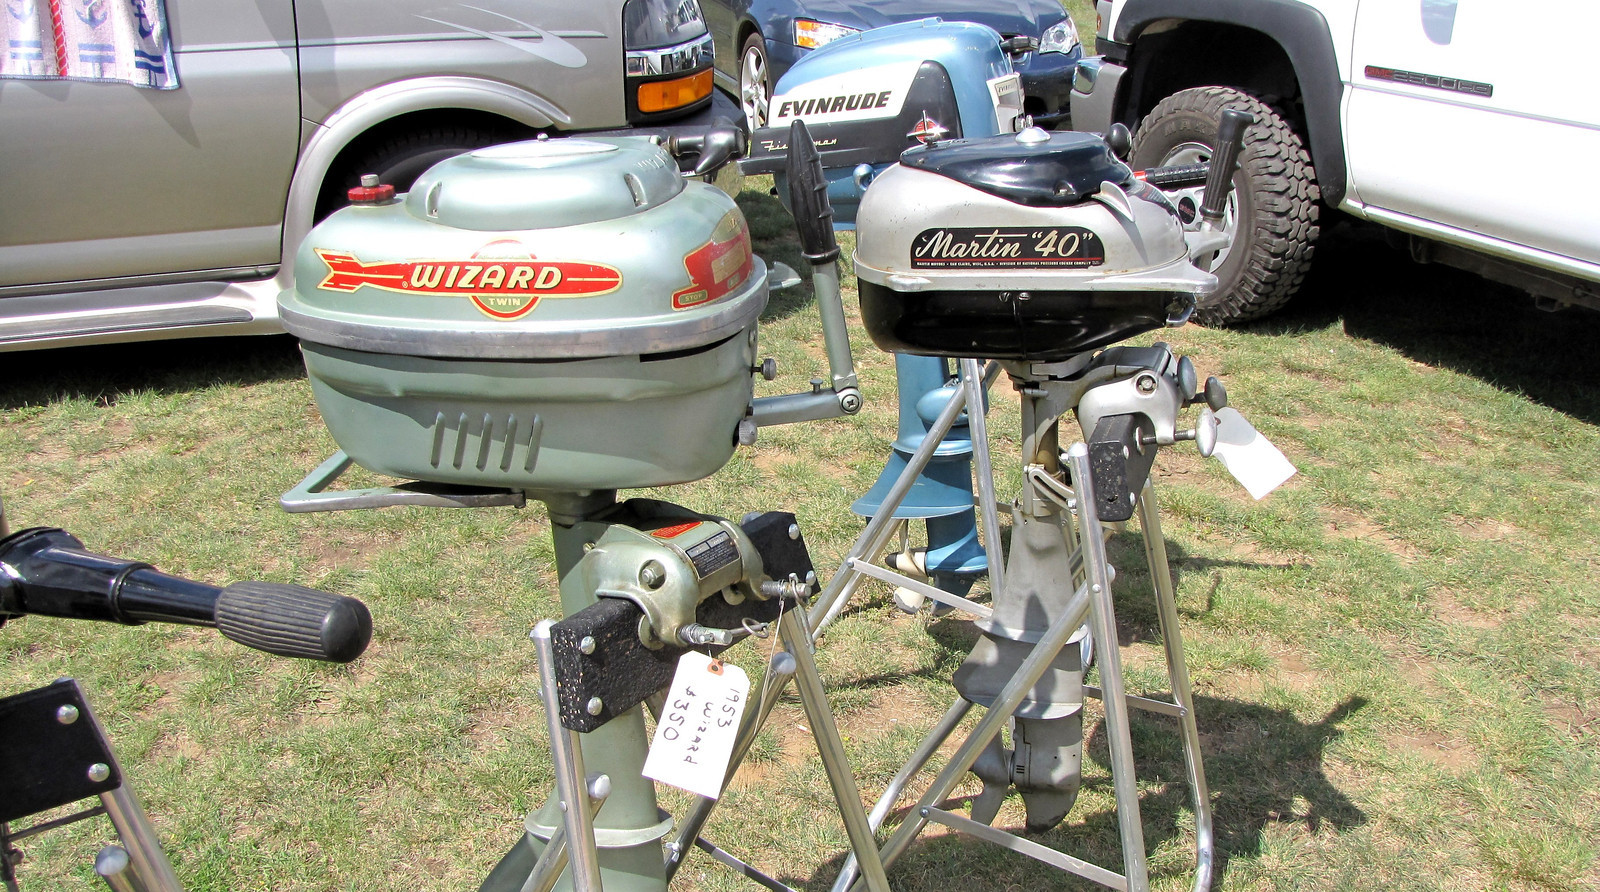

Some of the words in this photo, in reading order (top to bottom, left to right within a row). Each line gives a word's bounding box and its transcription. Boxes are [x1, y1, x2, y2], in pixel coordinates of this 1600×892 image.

[778, 91, 891, 118] EVINRUDE
[914, 229, 1027, 258] Martin
[410, 264, 563, 289] WIZARD
[488, 297, 521, 307] TWIN
[685, 292, 703, 301] STOP
[663, 686, 697, 741] $350
[717, 688, 740, 727] 1953
